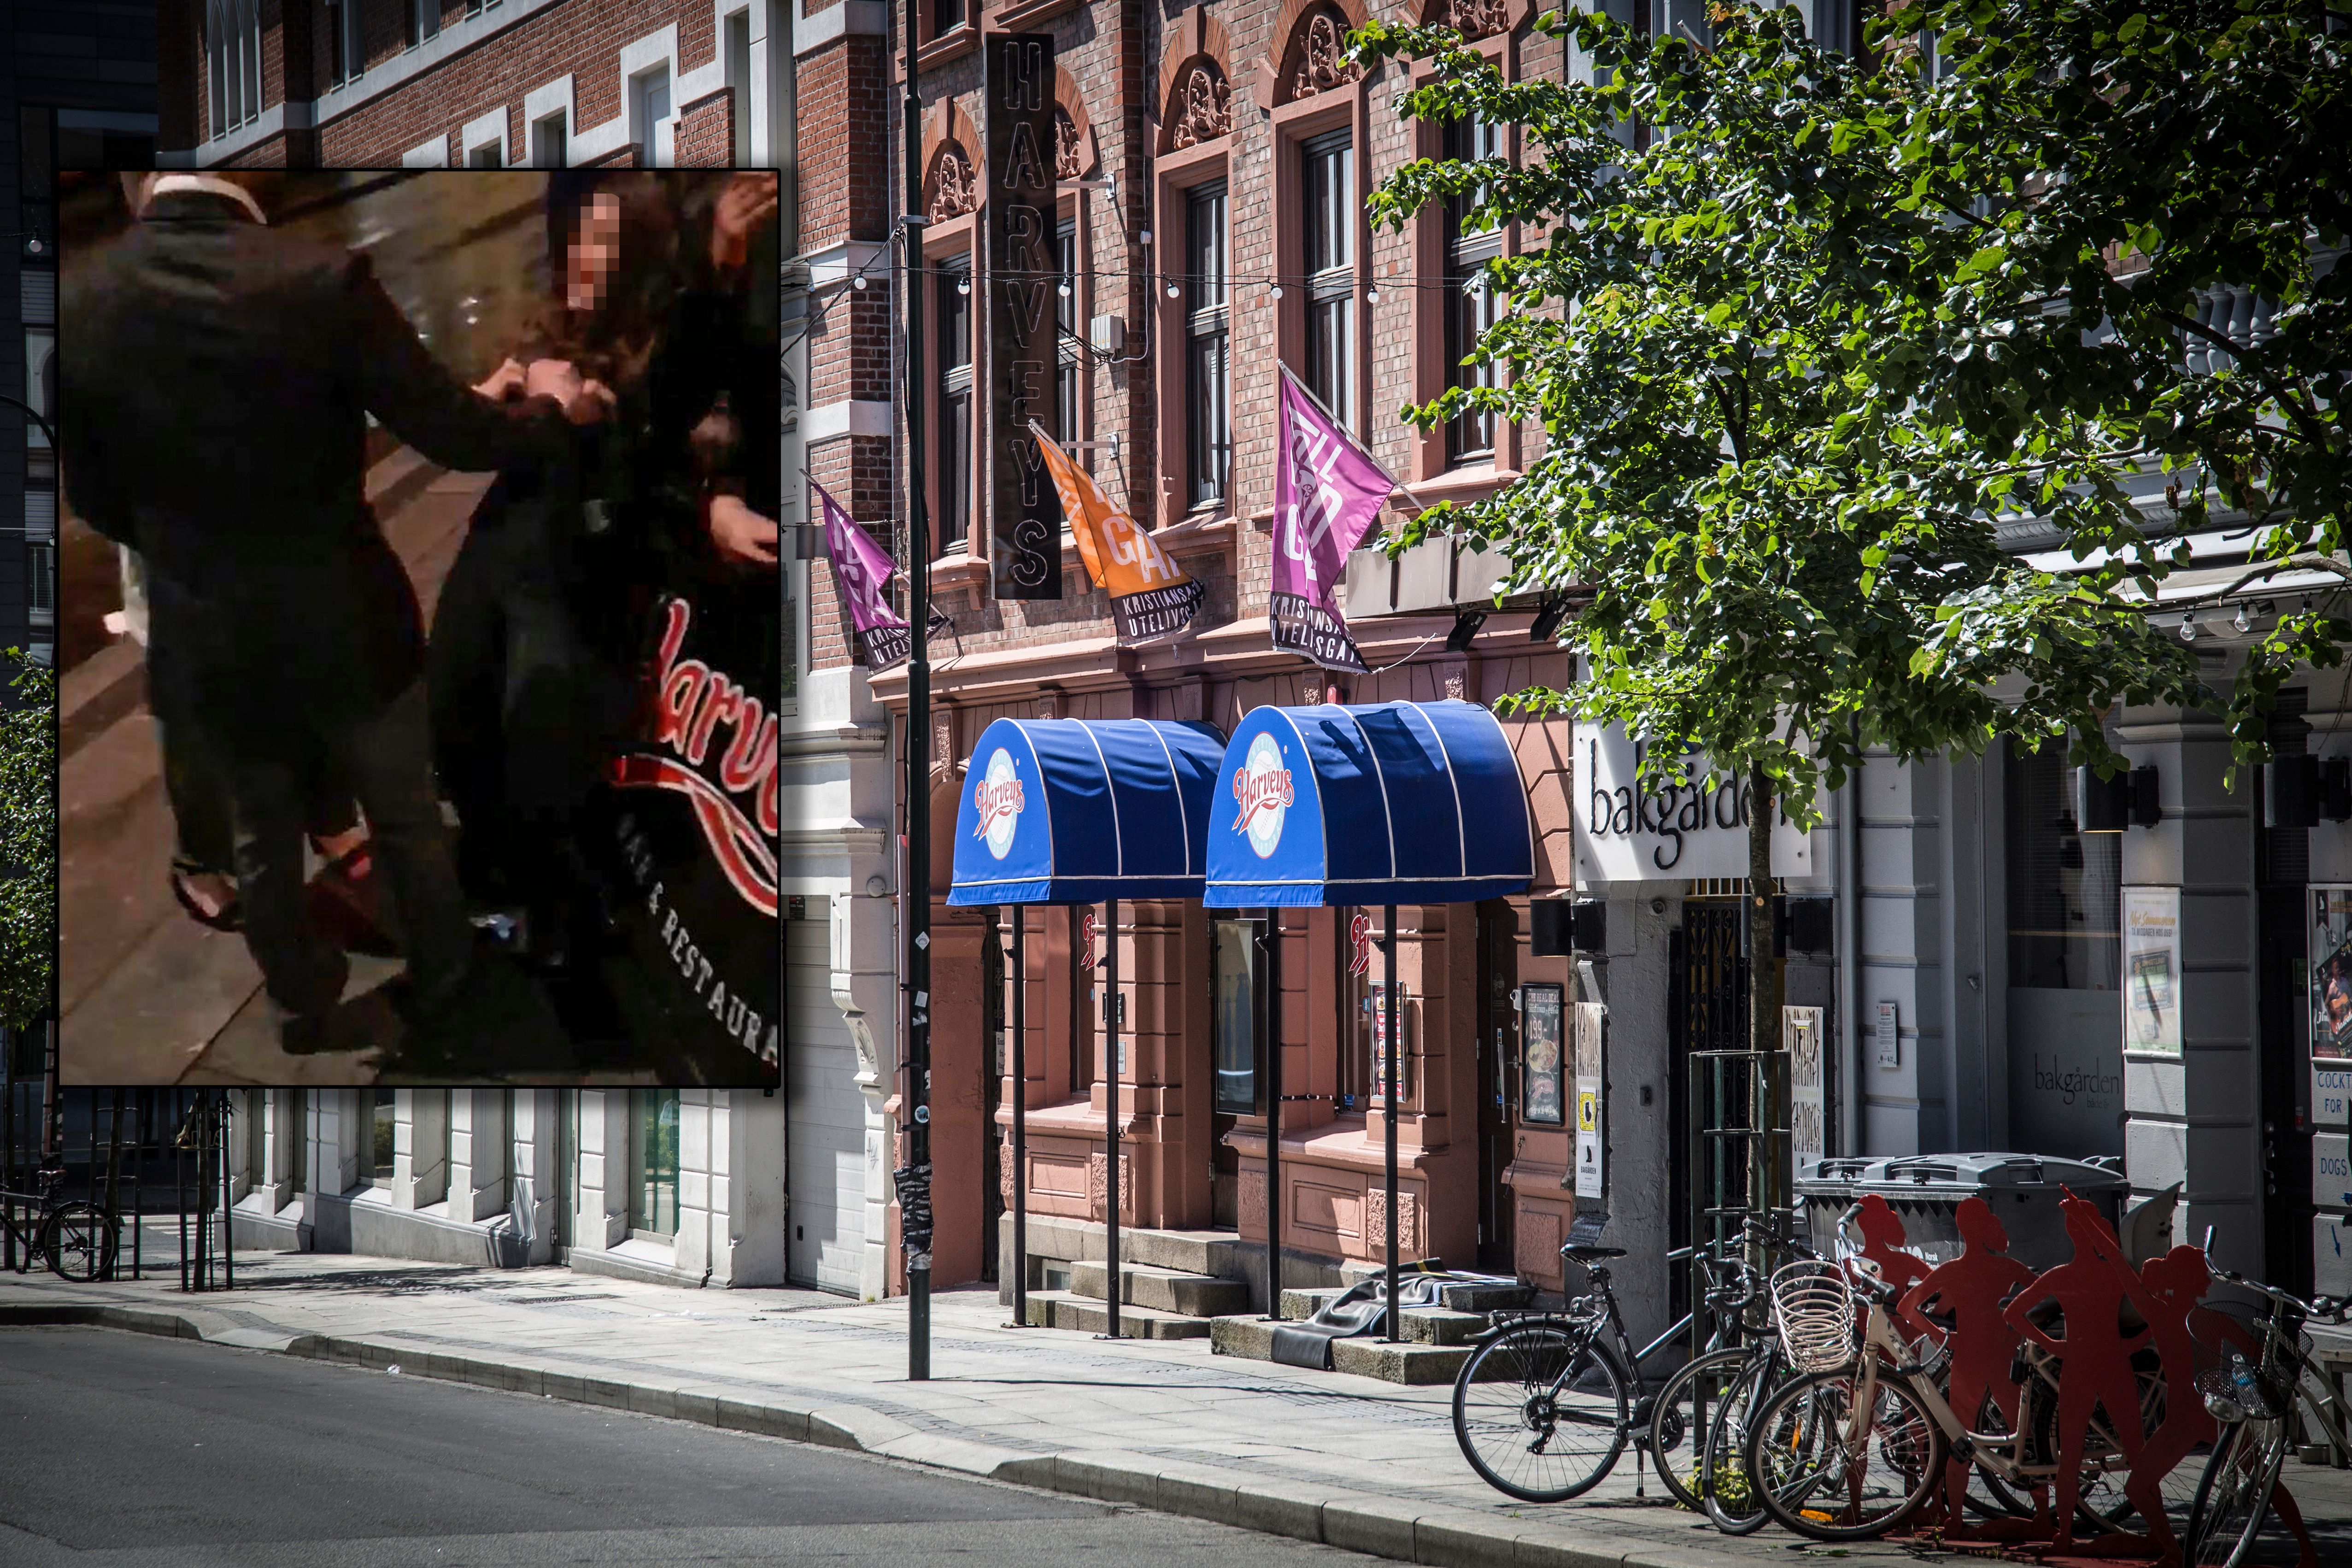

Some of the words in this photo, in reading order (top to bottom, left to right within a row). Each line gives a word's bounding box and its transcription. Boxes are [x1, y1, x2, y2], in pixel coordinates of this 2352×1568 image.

[1002, 41, 1049, 587] HARVEYS
[974, 779, 1025, 841] Harveys
[1232, 767, 1294, 836] Harveys
[1537, 993, 1548, 1002] REAL
[2035, 1052, 2119, 1105] bakgården
[2325, 1098, 2342, 1113] FOR
[2321, 1157, 2347, 1175] DOGS
[1925, 1251, 1938, 1262] Norsk
